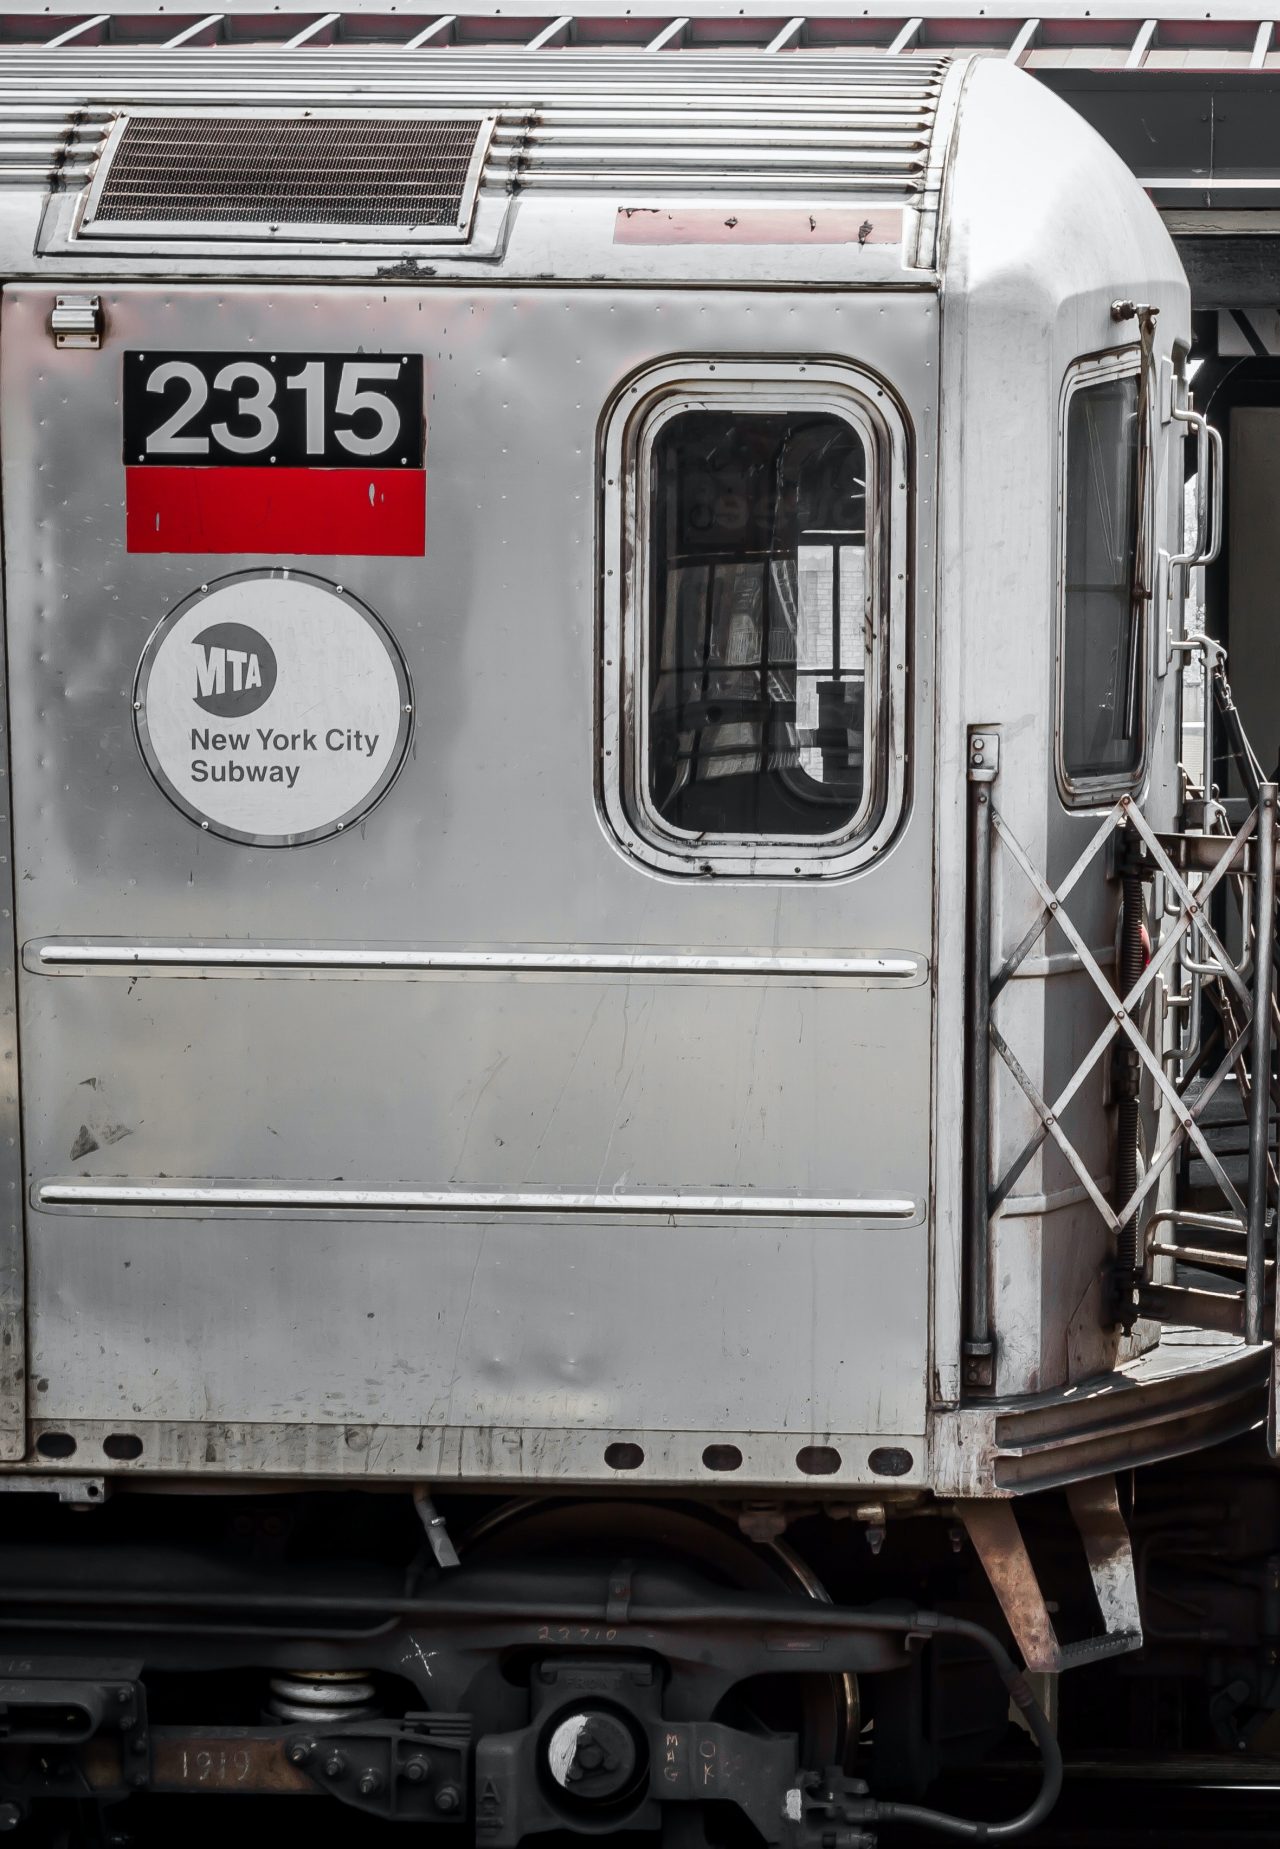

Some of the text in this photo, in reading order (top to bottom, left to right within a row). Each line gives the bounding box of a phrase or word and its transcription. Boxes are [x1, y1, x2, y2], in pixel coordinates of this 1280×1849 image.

[146, 361, 401, 455] 2315
[191, 643, 262, 700] MTA
[191, 729, 380, 757] New York City
[191, 760, 300, 788] Subway
